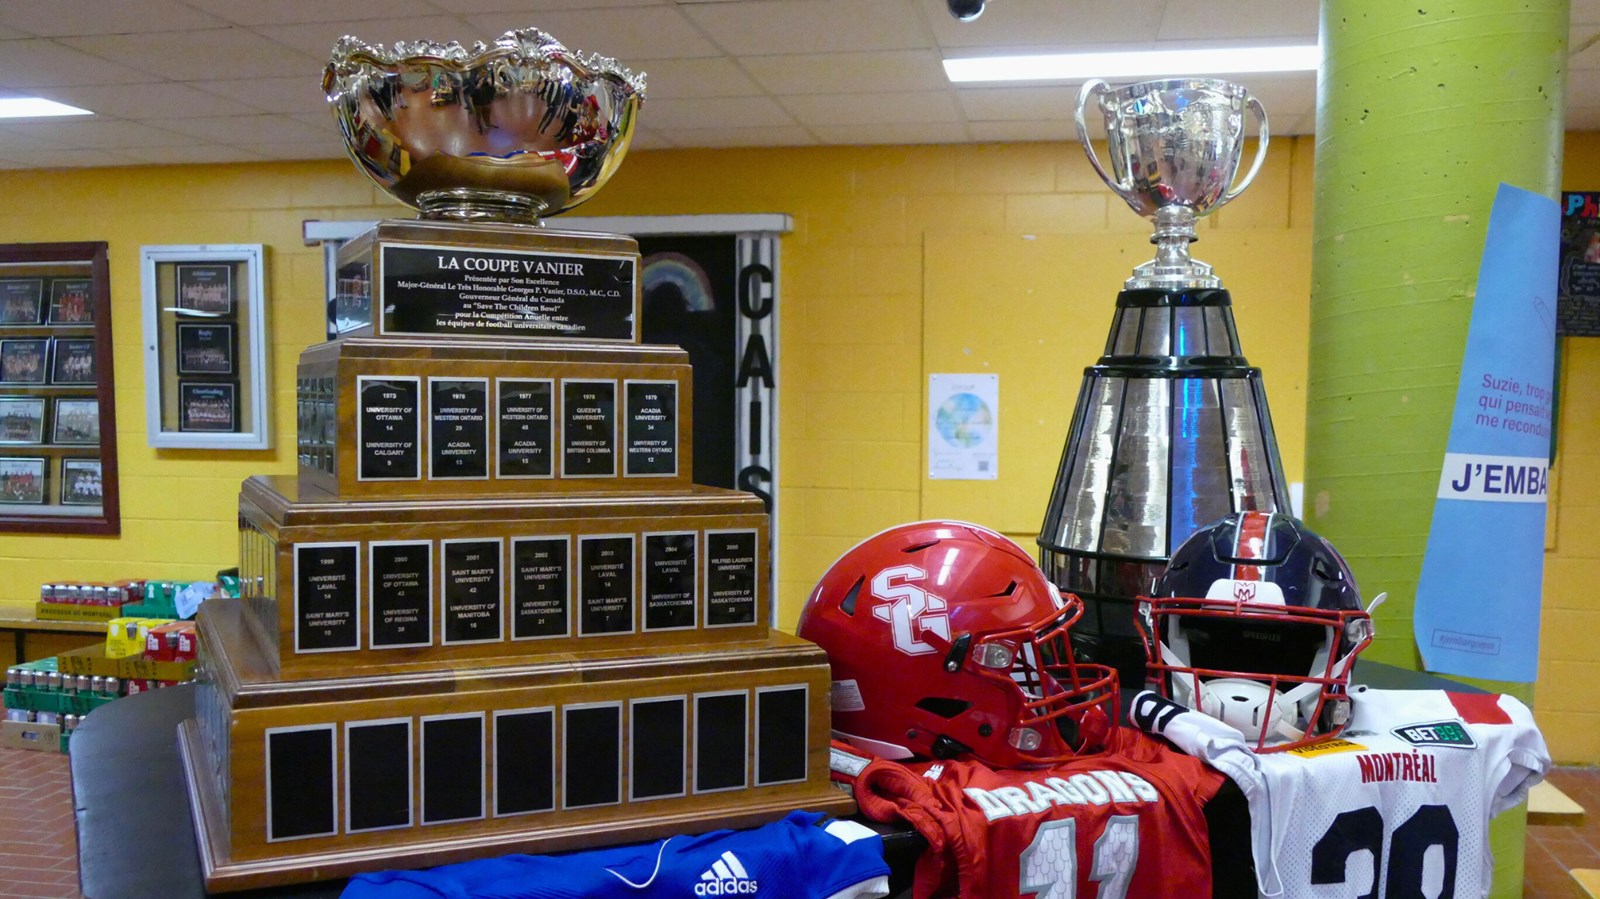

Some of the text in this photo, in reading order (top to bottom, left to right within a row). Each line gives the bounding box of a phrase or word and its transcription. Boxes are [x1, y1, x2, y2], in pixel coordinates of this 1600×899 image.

[438, 256, 584, 276] LA COUPE VANIER
[398, 281, 446, 289] Major-Général
[508, 286, 534, 294] Georges
[447, 320, 474, 328] équipes
[514, 322, 556, 330] universitaire
[480, 312, 522, 320] Compétition
[1482, 374, 1522, 396] Suzie,
[1526, 382, 1545, 400] trop
[1479, 394, 1502, 410] qui
[1476, 414, 1498, 428] me
[1452, 463, 1546, 494] J'EMBA
[1356, 749, 1437, 783] MONTRÉAL
[963, 770, 1158, 822] DRAGONS
[694, 877, 757, 896] adidas
